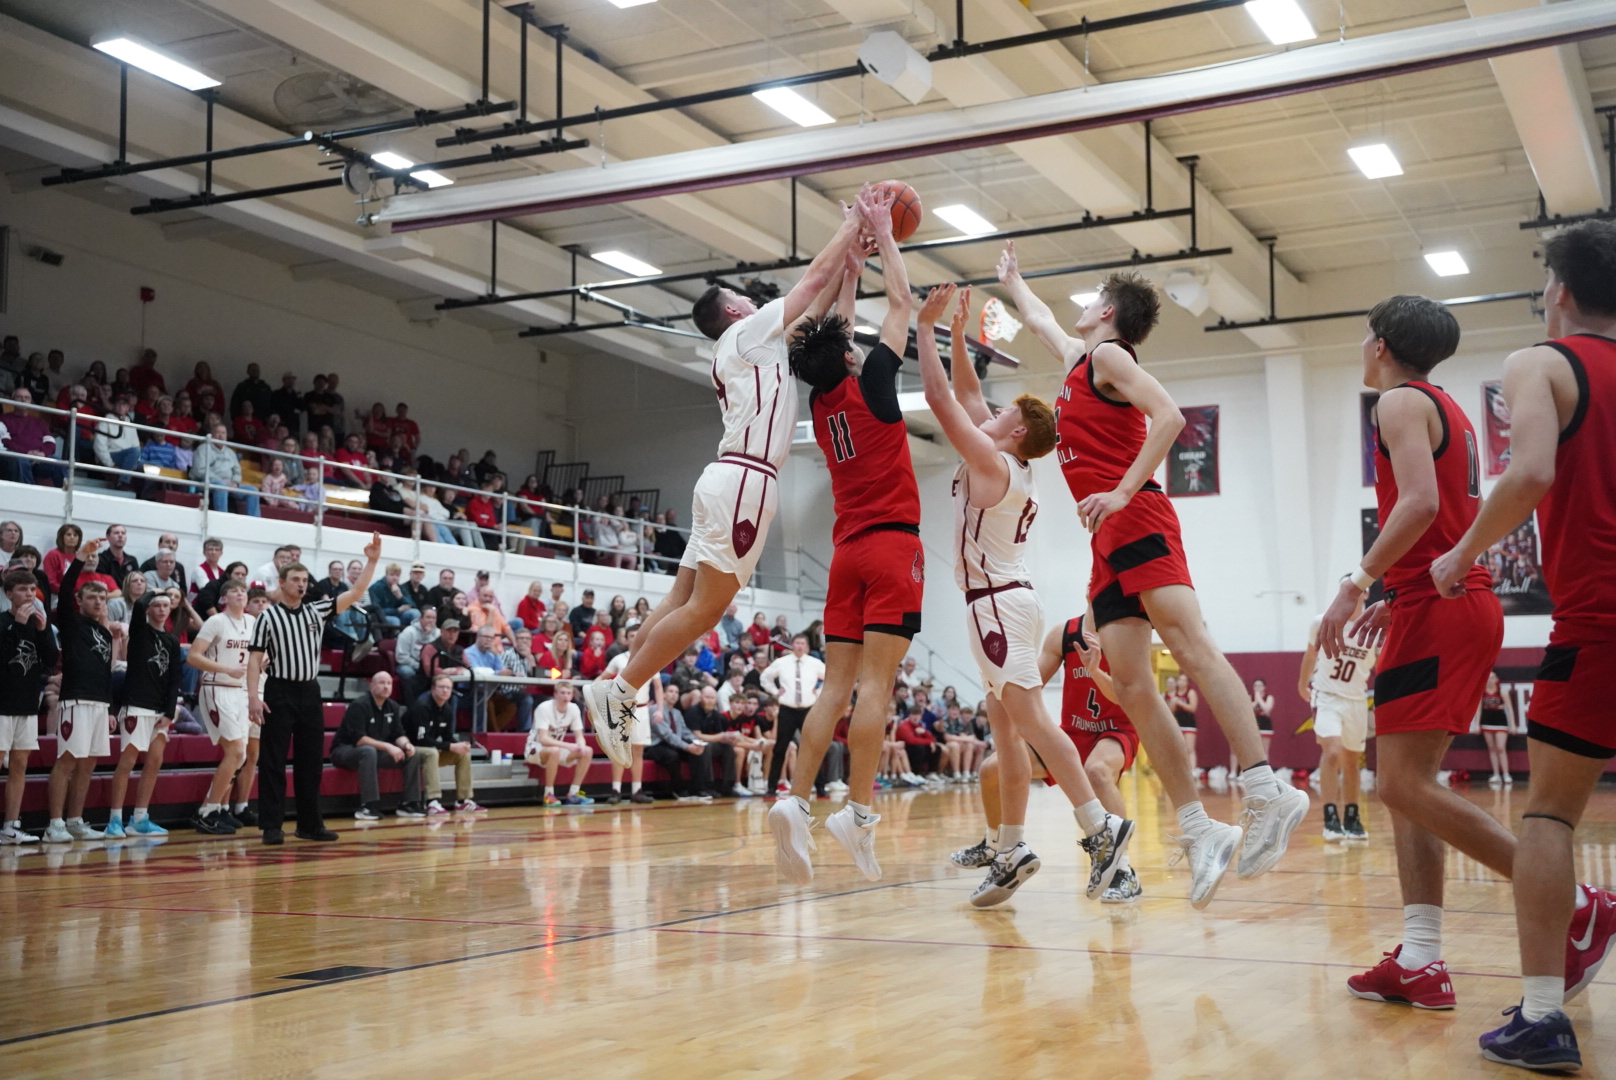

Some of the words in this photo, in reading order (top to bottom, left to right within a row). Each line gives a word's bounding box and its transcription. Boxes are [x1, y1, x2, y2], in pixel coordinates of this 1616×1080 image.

[827, 411, 856, 463] 11
[1342, 647, 1368, 660] EDES
[1329, 658, 1356, 683] 30
[1087, 687, 1100, 719] 4
